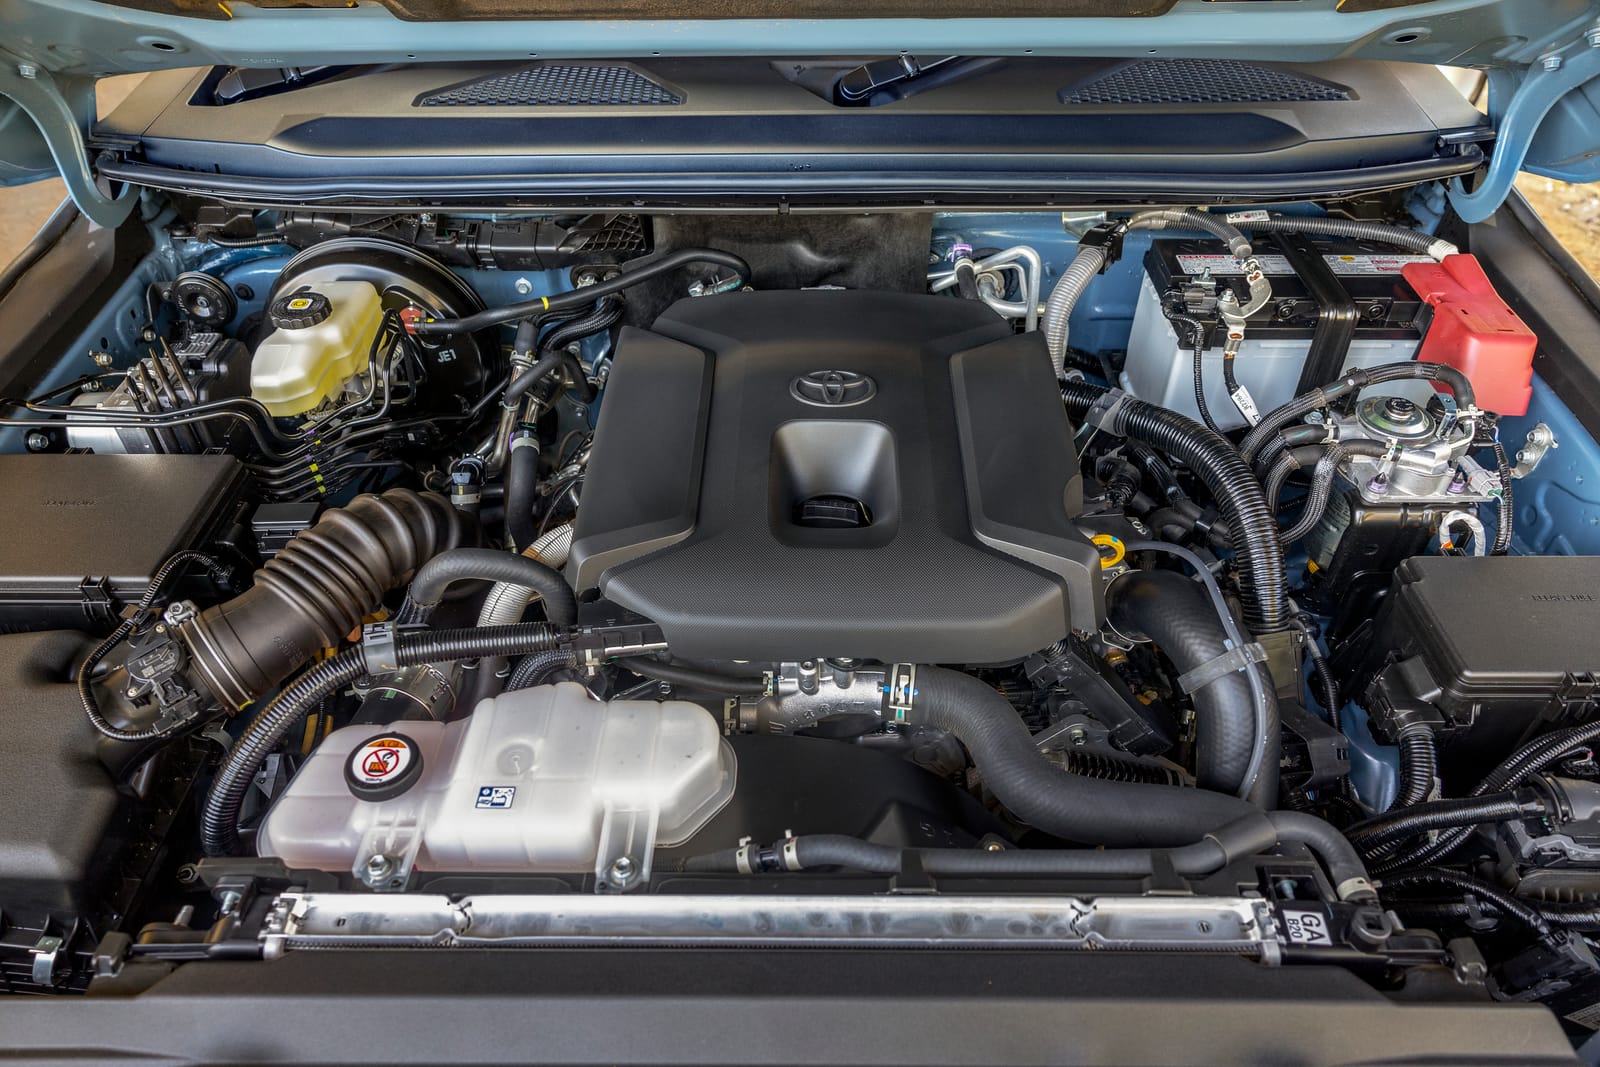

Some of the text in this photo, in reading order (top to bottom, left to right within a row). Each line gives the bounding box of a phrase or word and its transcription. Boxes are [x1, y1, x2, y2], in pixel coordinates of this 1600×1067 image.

[437, 349, 457, 362] JE1
[1287, 918, 1303, 939] B20
[1300, 913, 1326, 942] GA
